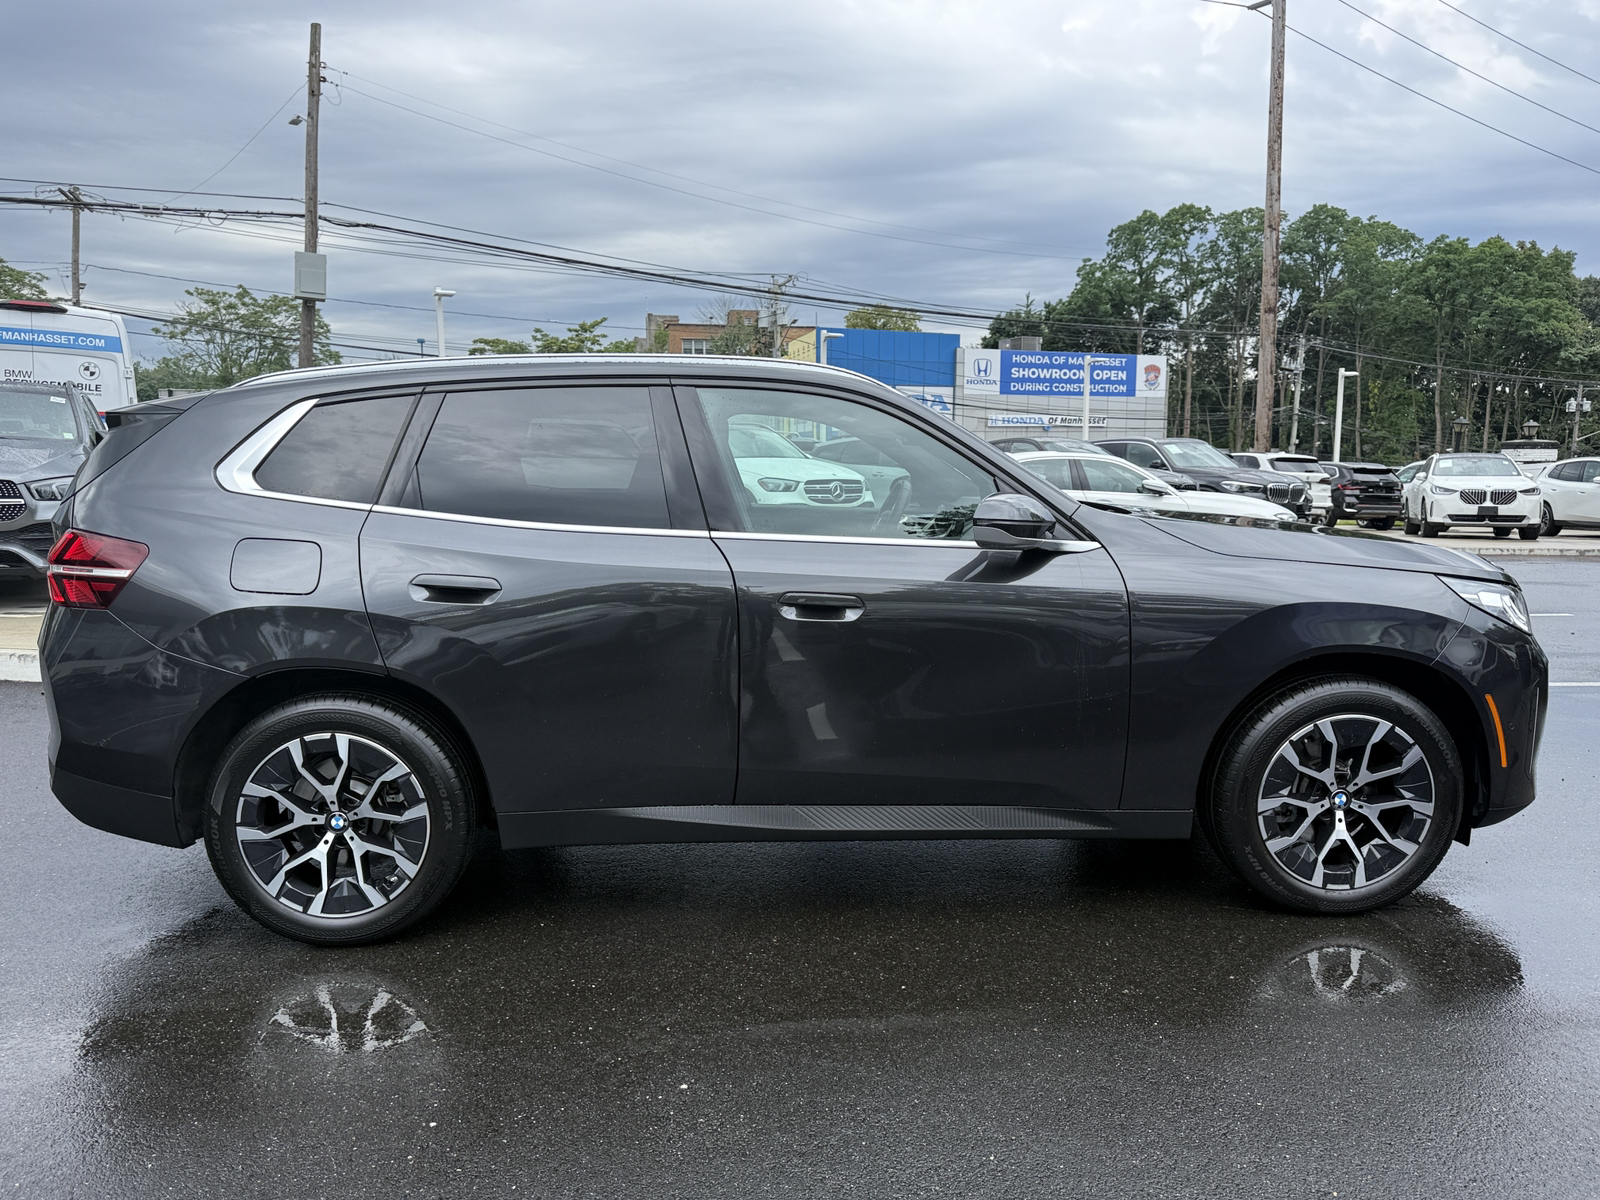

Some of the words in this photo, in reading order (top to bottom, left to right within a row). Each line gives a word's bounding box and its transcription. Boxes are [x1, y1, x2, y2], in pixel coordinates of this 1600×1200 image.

[1012, 355, 1051, 365] HONDA
[1052, 356, 1067, 365] OF
[1068, 357, 1127, 367] MAASSET
[4, 369, 32, 379] BMW
[1093, 370, 1127, 380] OPEN
[1010, 382, 1050, 391] DURING
[1055, 383, 1127, 393] CONSTUCTION
[1001, 416, 1045, 425] HONDA
[1060, 416, 1106, 425] Manhsset
